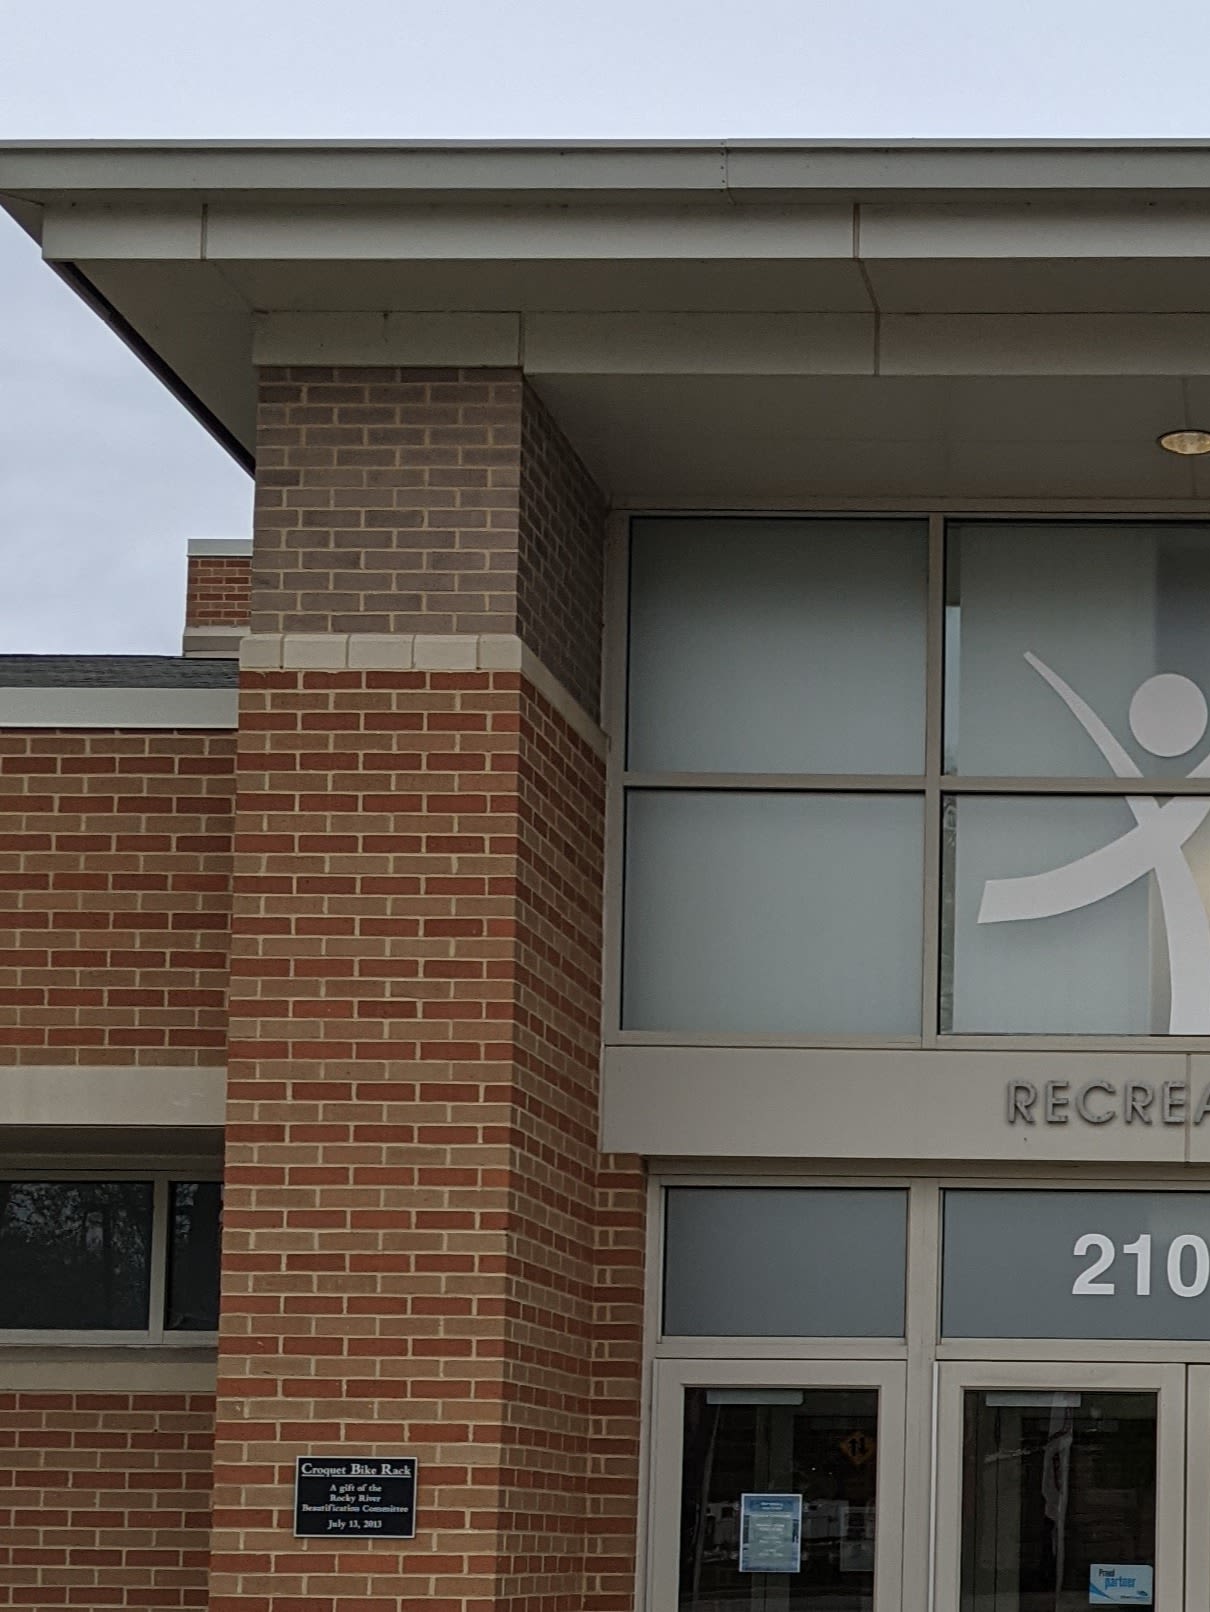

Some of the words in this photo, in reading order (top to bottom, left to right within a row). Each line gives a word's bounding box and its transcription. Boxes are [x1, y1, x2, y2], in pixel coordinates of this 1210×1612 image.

[301, 1463, 347, 1476] Croquet
[351, 1463, 378, 1475] Bike
[381, 1463, 412, 1476] Rack
[329, 1484, 337, 1492] A
[339, 1484, 356, 1493] gift
[357, 1484, 368, 1492] of
[368, 1484, 383, 1492] the
[329, 1494, 357, 1504] Rocky
[358, 1494, 382, 1503] River
[302, 1503, 360, 1512] Beautification
[362, 1504, 409, 1513] Committee
[327, 1519, 347, 1530] July
[363, 1520, 383, 1529] 2013
